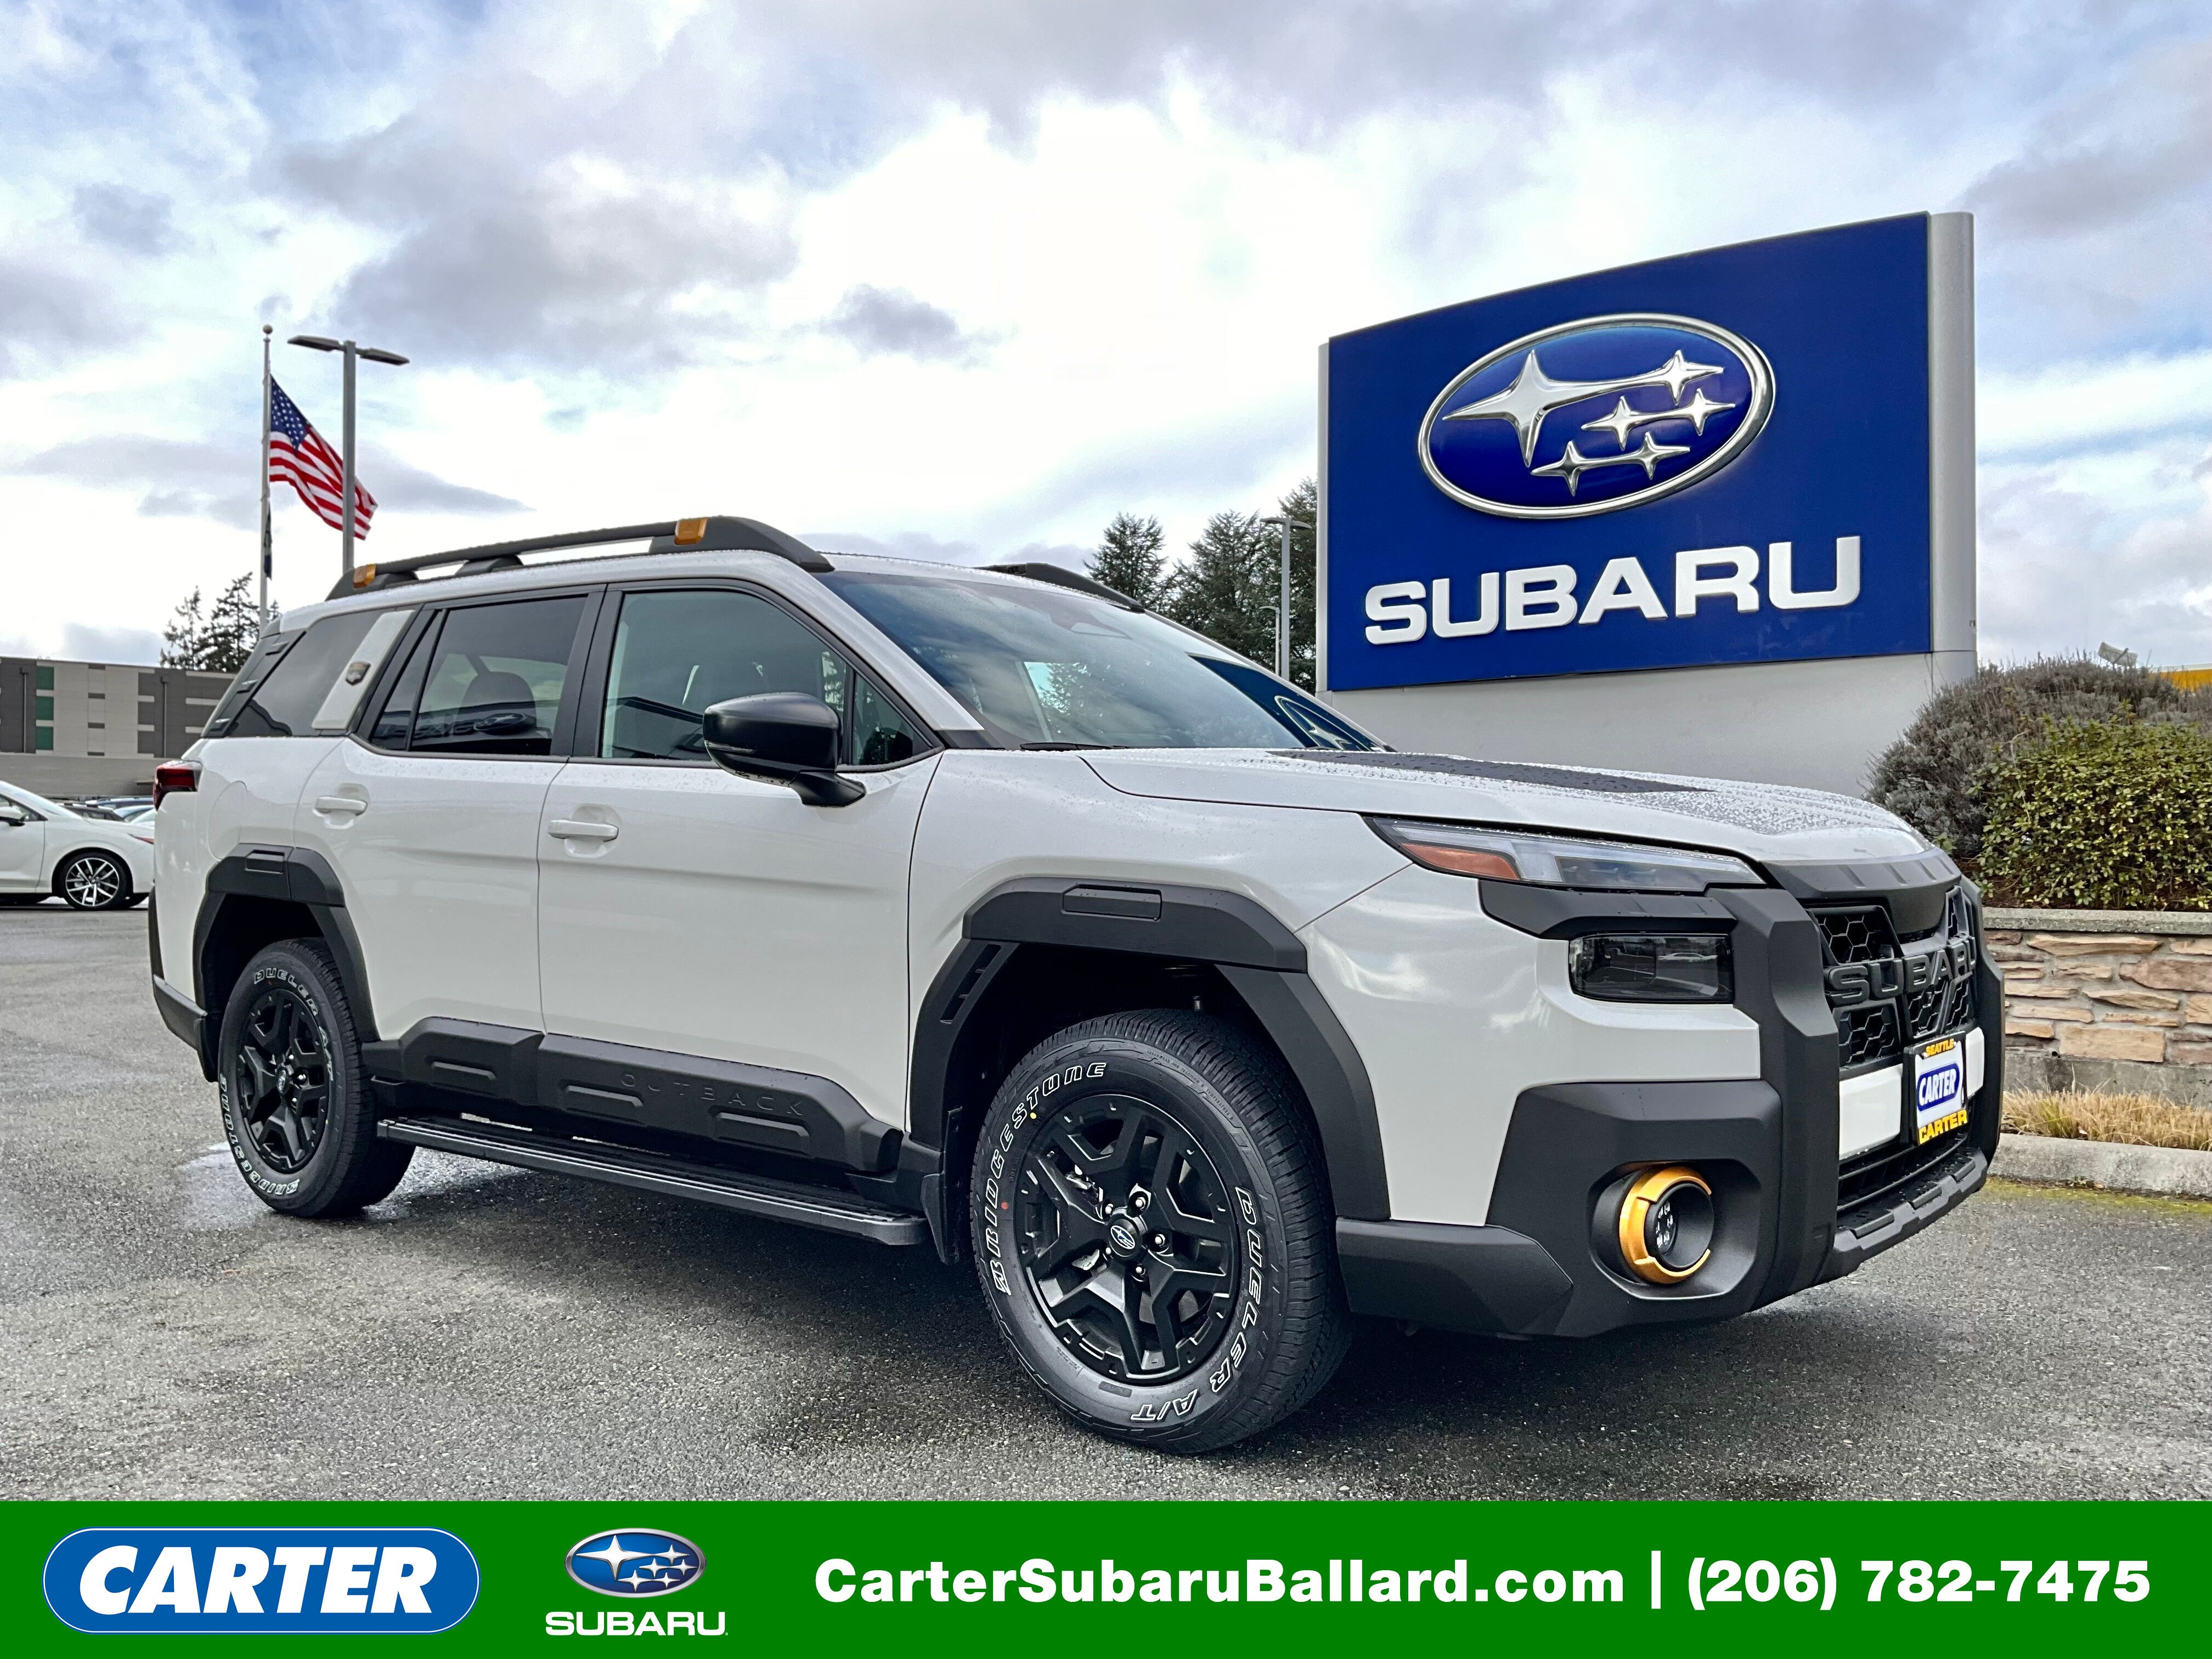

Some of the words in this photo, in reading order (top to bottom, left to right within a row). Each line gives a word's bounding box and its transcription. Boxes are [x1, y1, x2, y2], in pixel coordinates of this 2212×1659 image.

[1365, 535, 1860, 645] SUBARU
[254, 968, 318, 1015] DUELER
[1926, 1038, 1954, 1057] SEATTLE
[620, 1074, 803, 1116] OUTBACK
[1918, 1068, 1957, 1107] CARTER
[1918, 1109, 1968, 1145] CARTER
[983, 1061, 1108, 1296] BRIDGESTONE
[1209, 1186, 1263, 1393] DUELER
[1130, 1389, 1199, 1421] A/T
